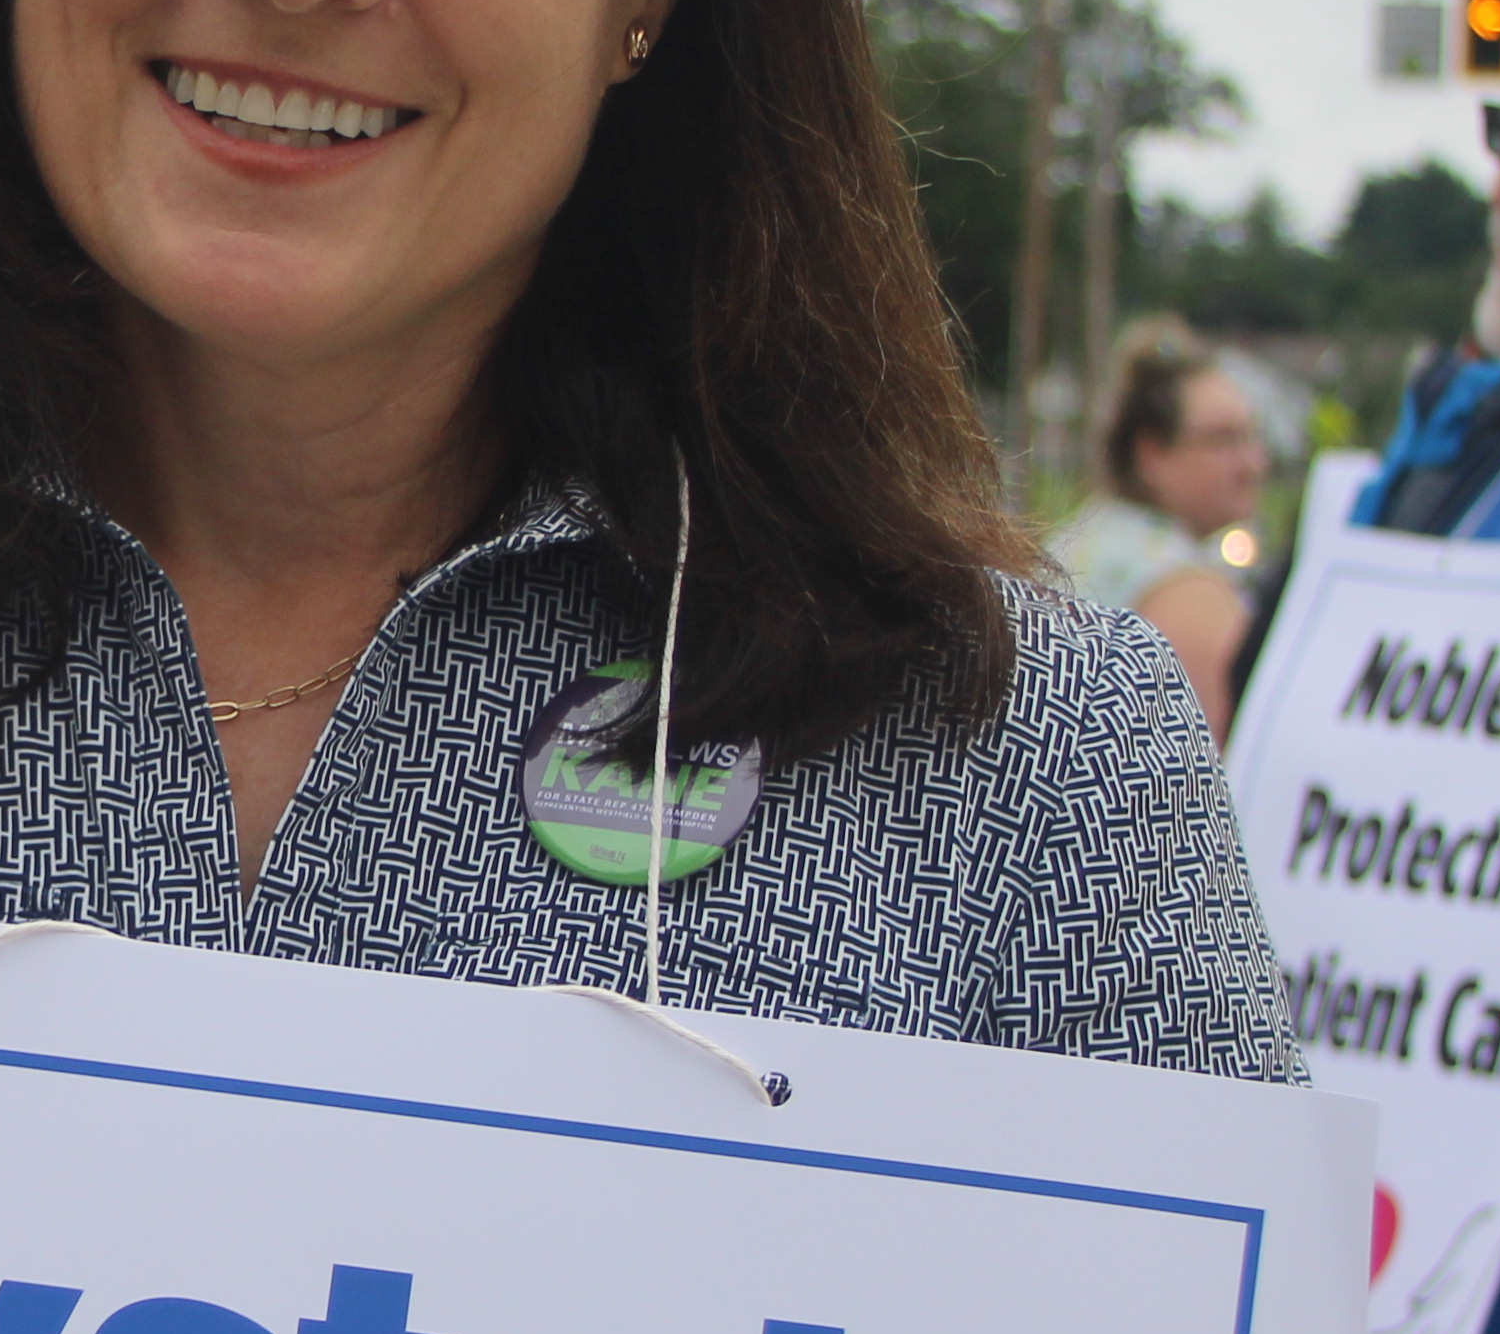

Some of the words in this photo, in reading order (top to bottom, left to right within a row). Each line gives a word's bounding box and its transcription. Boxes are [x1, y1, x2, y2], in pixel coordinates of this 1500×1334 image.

[540, 746, 733, 812] KANE
[537, 790, 560, 802] FOR
[564, 794, 600, 807] STATE
[604, 799, 628, 810] REP
[664, 807, 718, 824] AMPDEN
